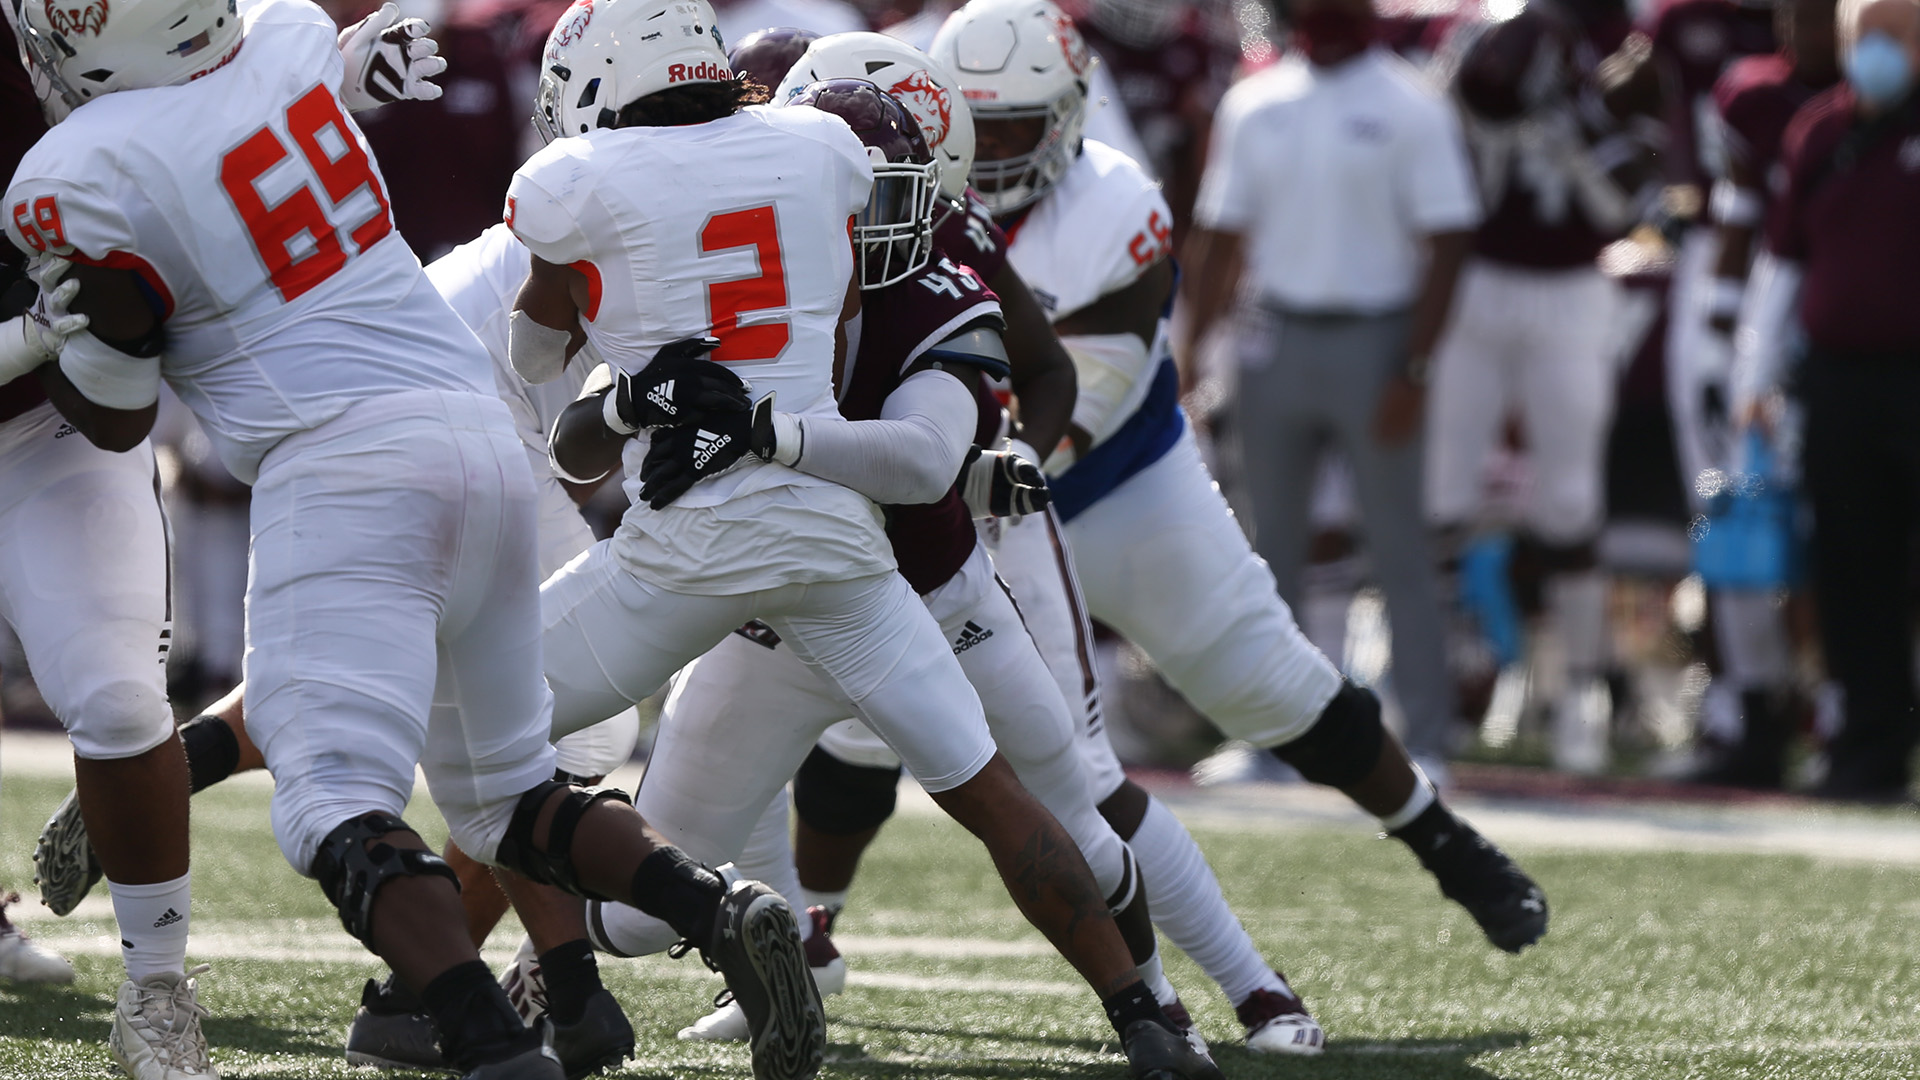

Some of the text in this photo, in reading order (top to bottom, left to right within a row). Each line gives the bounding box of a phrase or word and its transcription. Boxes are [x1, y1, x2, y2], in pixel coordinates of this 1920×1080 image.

[668, 61, 733, 83] Riddell
[215, 79, 393, 305] 69
[13, 193, 67, 252] 69
[696, 200, 793, 367] 2
[917, 257, 980, 300] 45
[647, 391, 678, 415] adidas
[55, 425, 77, 439] adi
[694, 434, 732, 470] adidas
[953, 629, 993, 655] adidas
